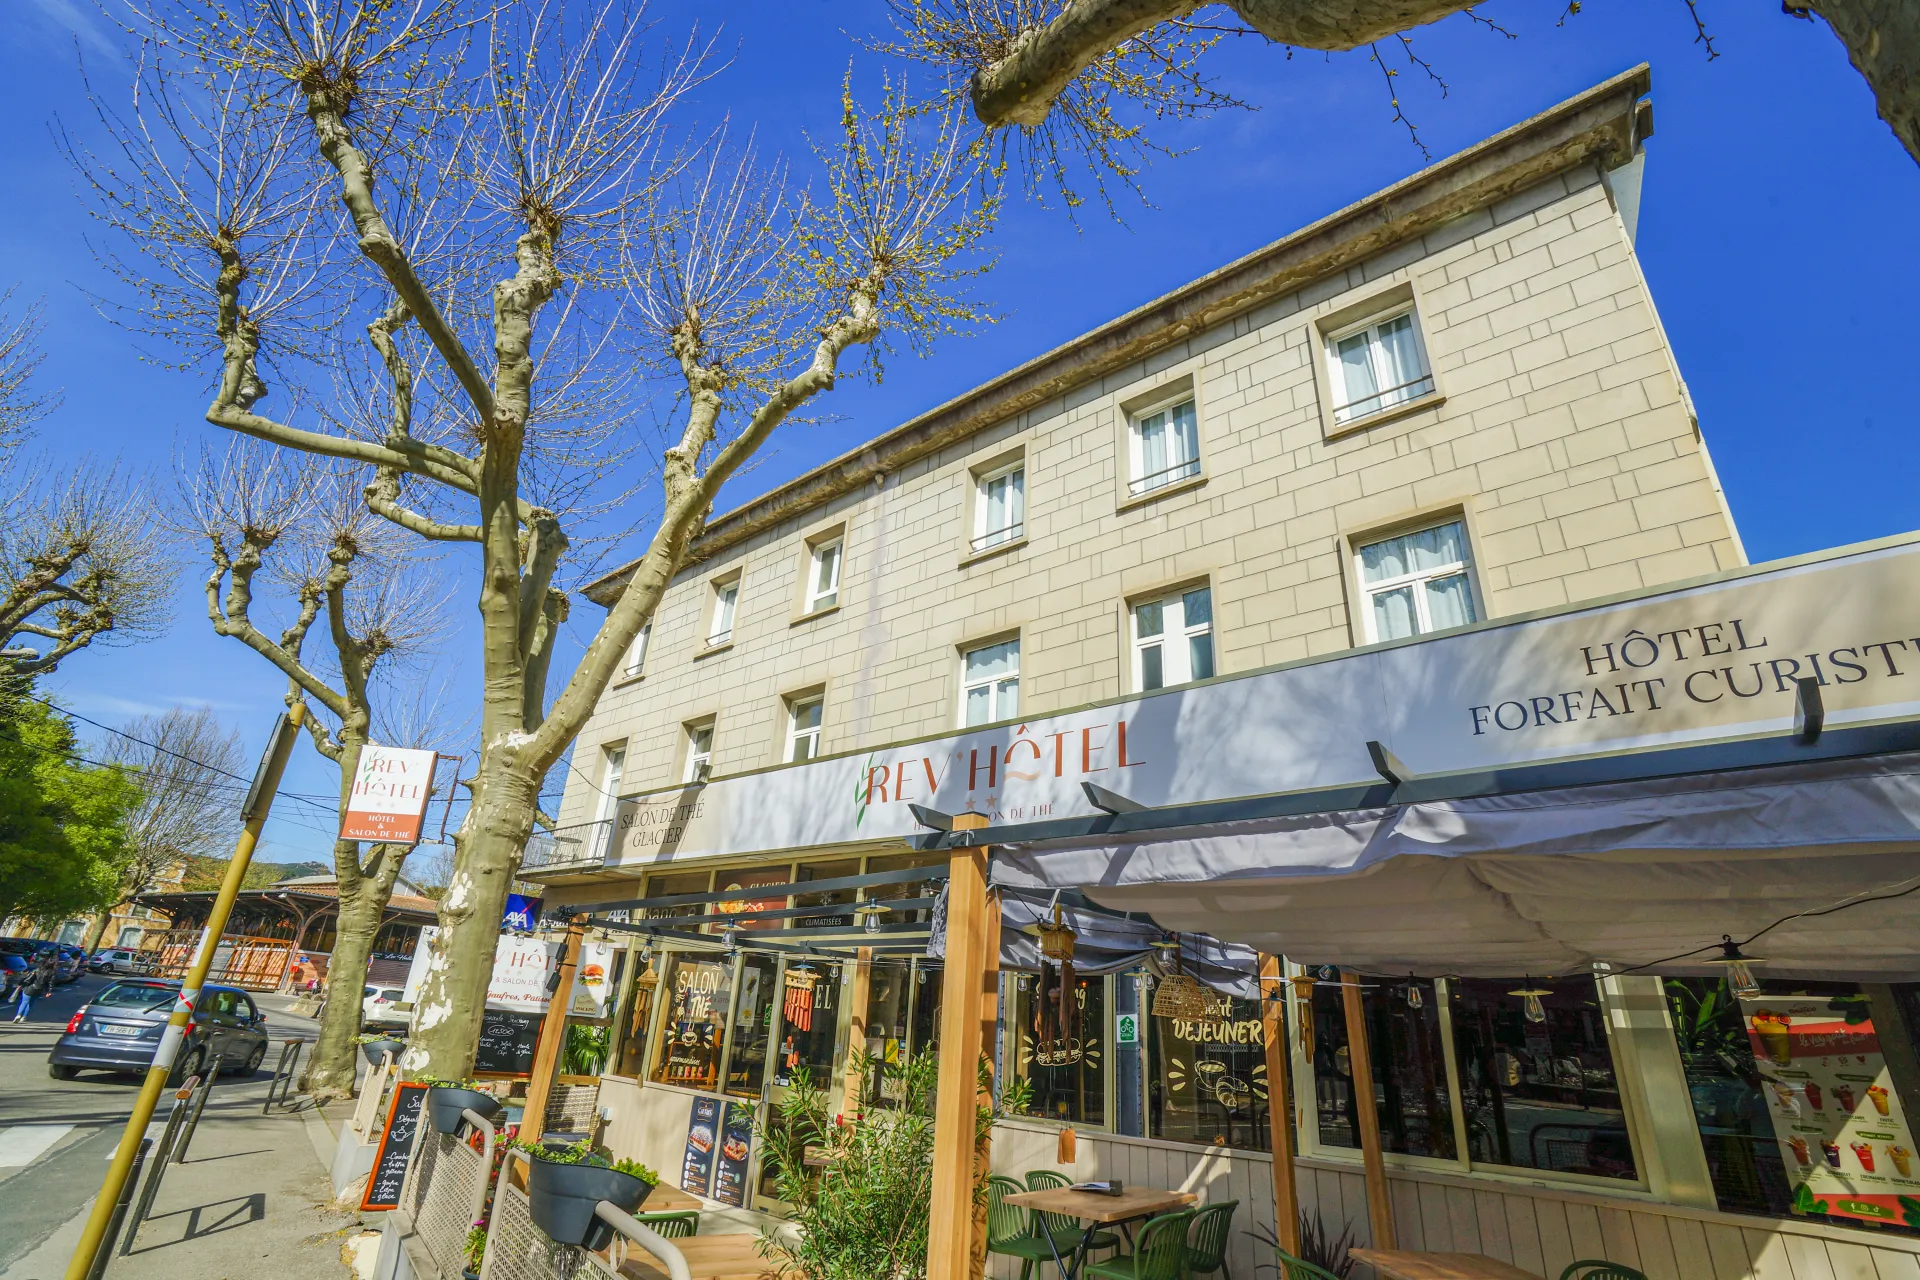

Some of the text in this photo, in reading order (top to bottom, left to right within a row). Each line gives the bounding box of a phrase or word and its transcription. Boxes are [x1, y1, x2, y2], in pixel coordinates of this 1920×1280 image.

[1579, 618, 1768, 676] HÔTEL
[1469, 637, 1920, 735] FORFAIT CURIST
[355, 777, 422, 799] HÔTEL
[368, 814, 396, 823] HÔTEL
[621, 798, 705, 829] SALON DE THÉ
[1010, 808, 1025, 819] DE
[1033, 801, 1055, 817] THÉ
[349, 828, 377, 837] SALON
[394, 830, 410, 839] THÉ
[632, 827, 682, 847] GLACIER
[503, 911, 528, 928] AXA
[805, 917, 842, 926] CLIMATISÉES
[502, 977, 527, 985] SALON
[679, 970, 719, 994] SALON
[691, 995, 711, 1018] THÉ
